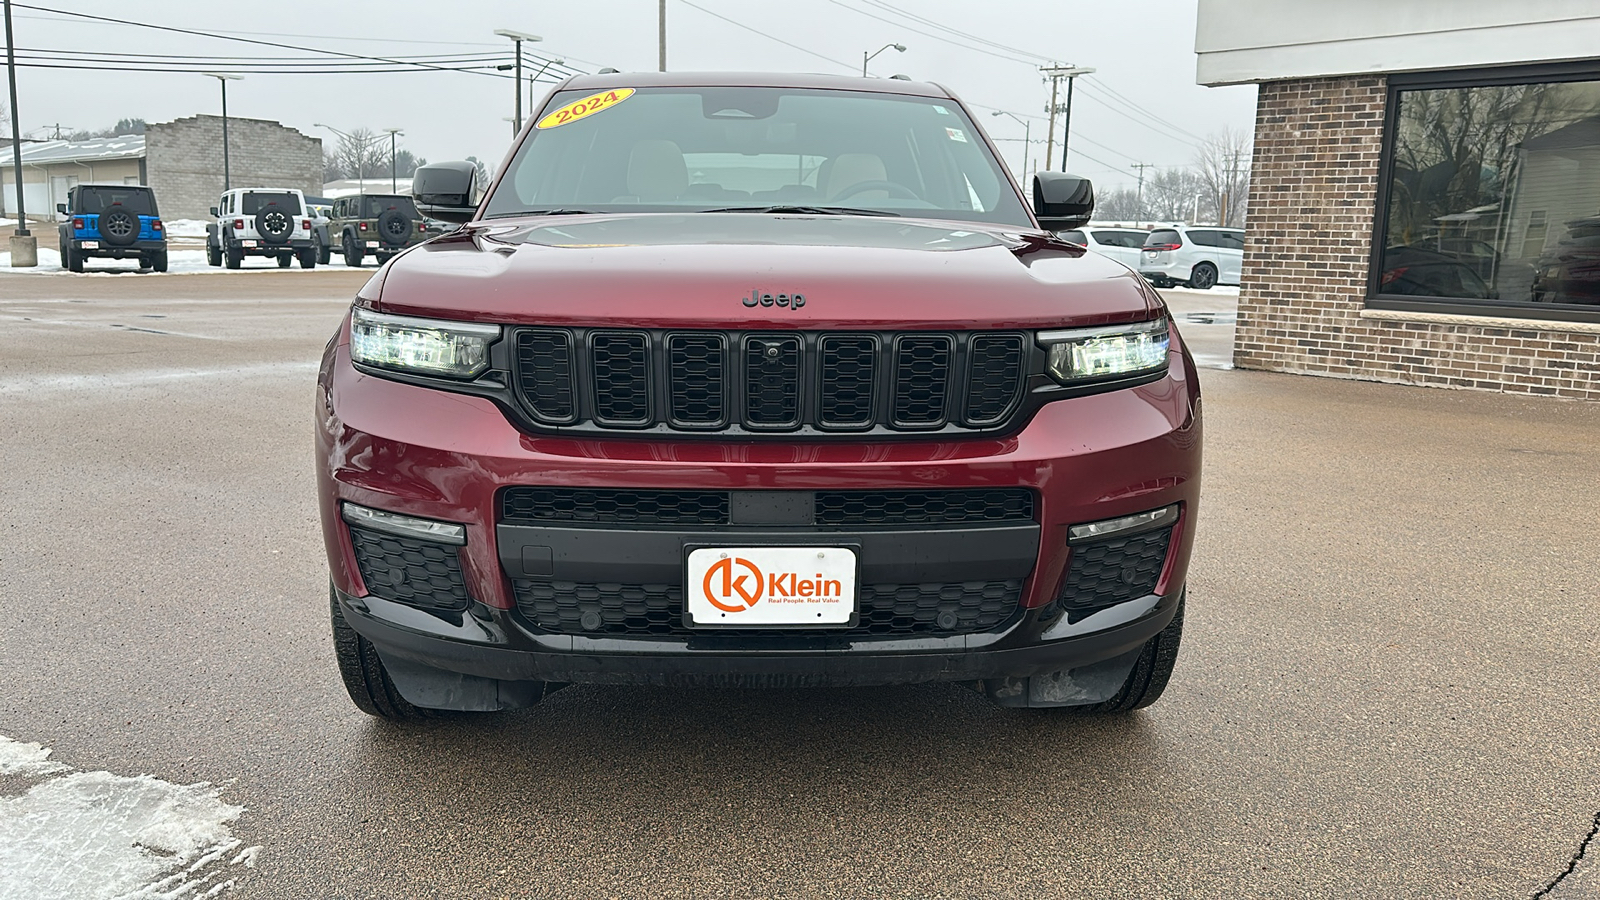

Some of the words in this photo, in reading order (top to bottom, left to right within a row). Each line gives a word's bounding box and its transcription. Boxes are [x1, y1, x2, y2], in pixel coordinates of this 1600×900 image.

[555, 91, 620, 124] 2024
[742, 290, 806, 311] Jeep
[768, 572, 842, 597] Klein
